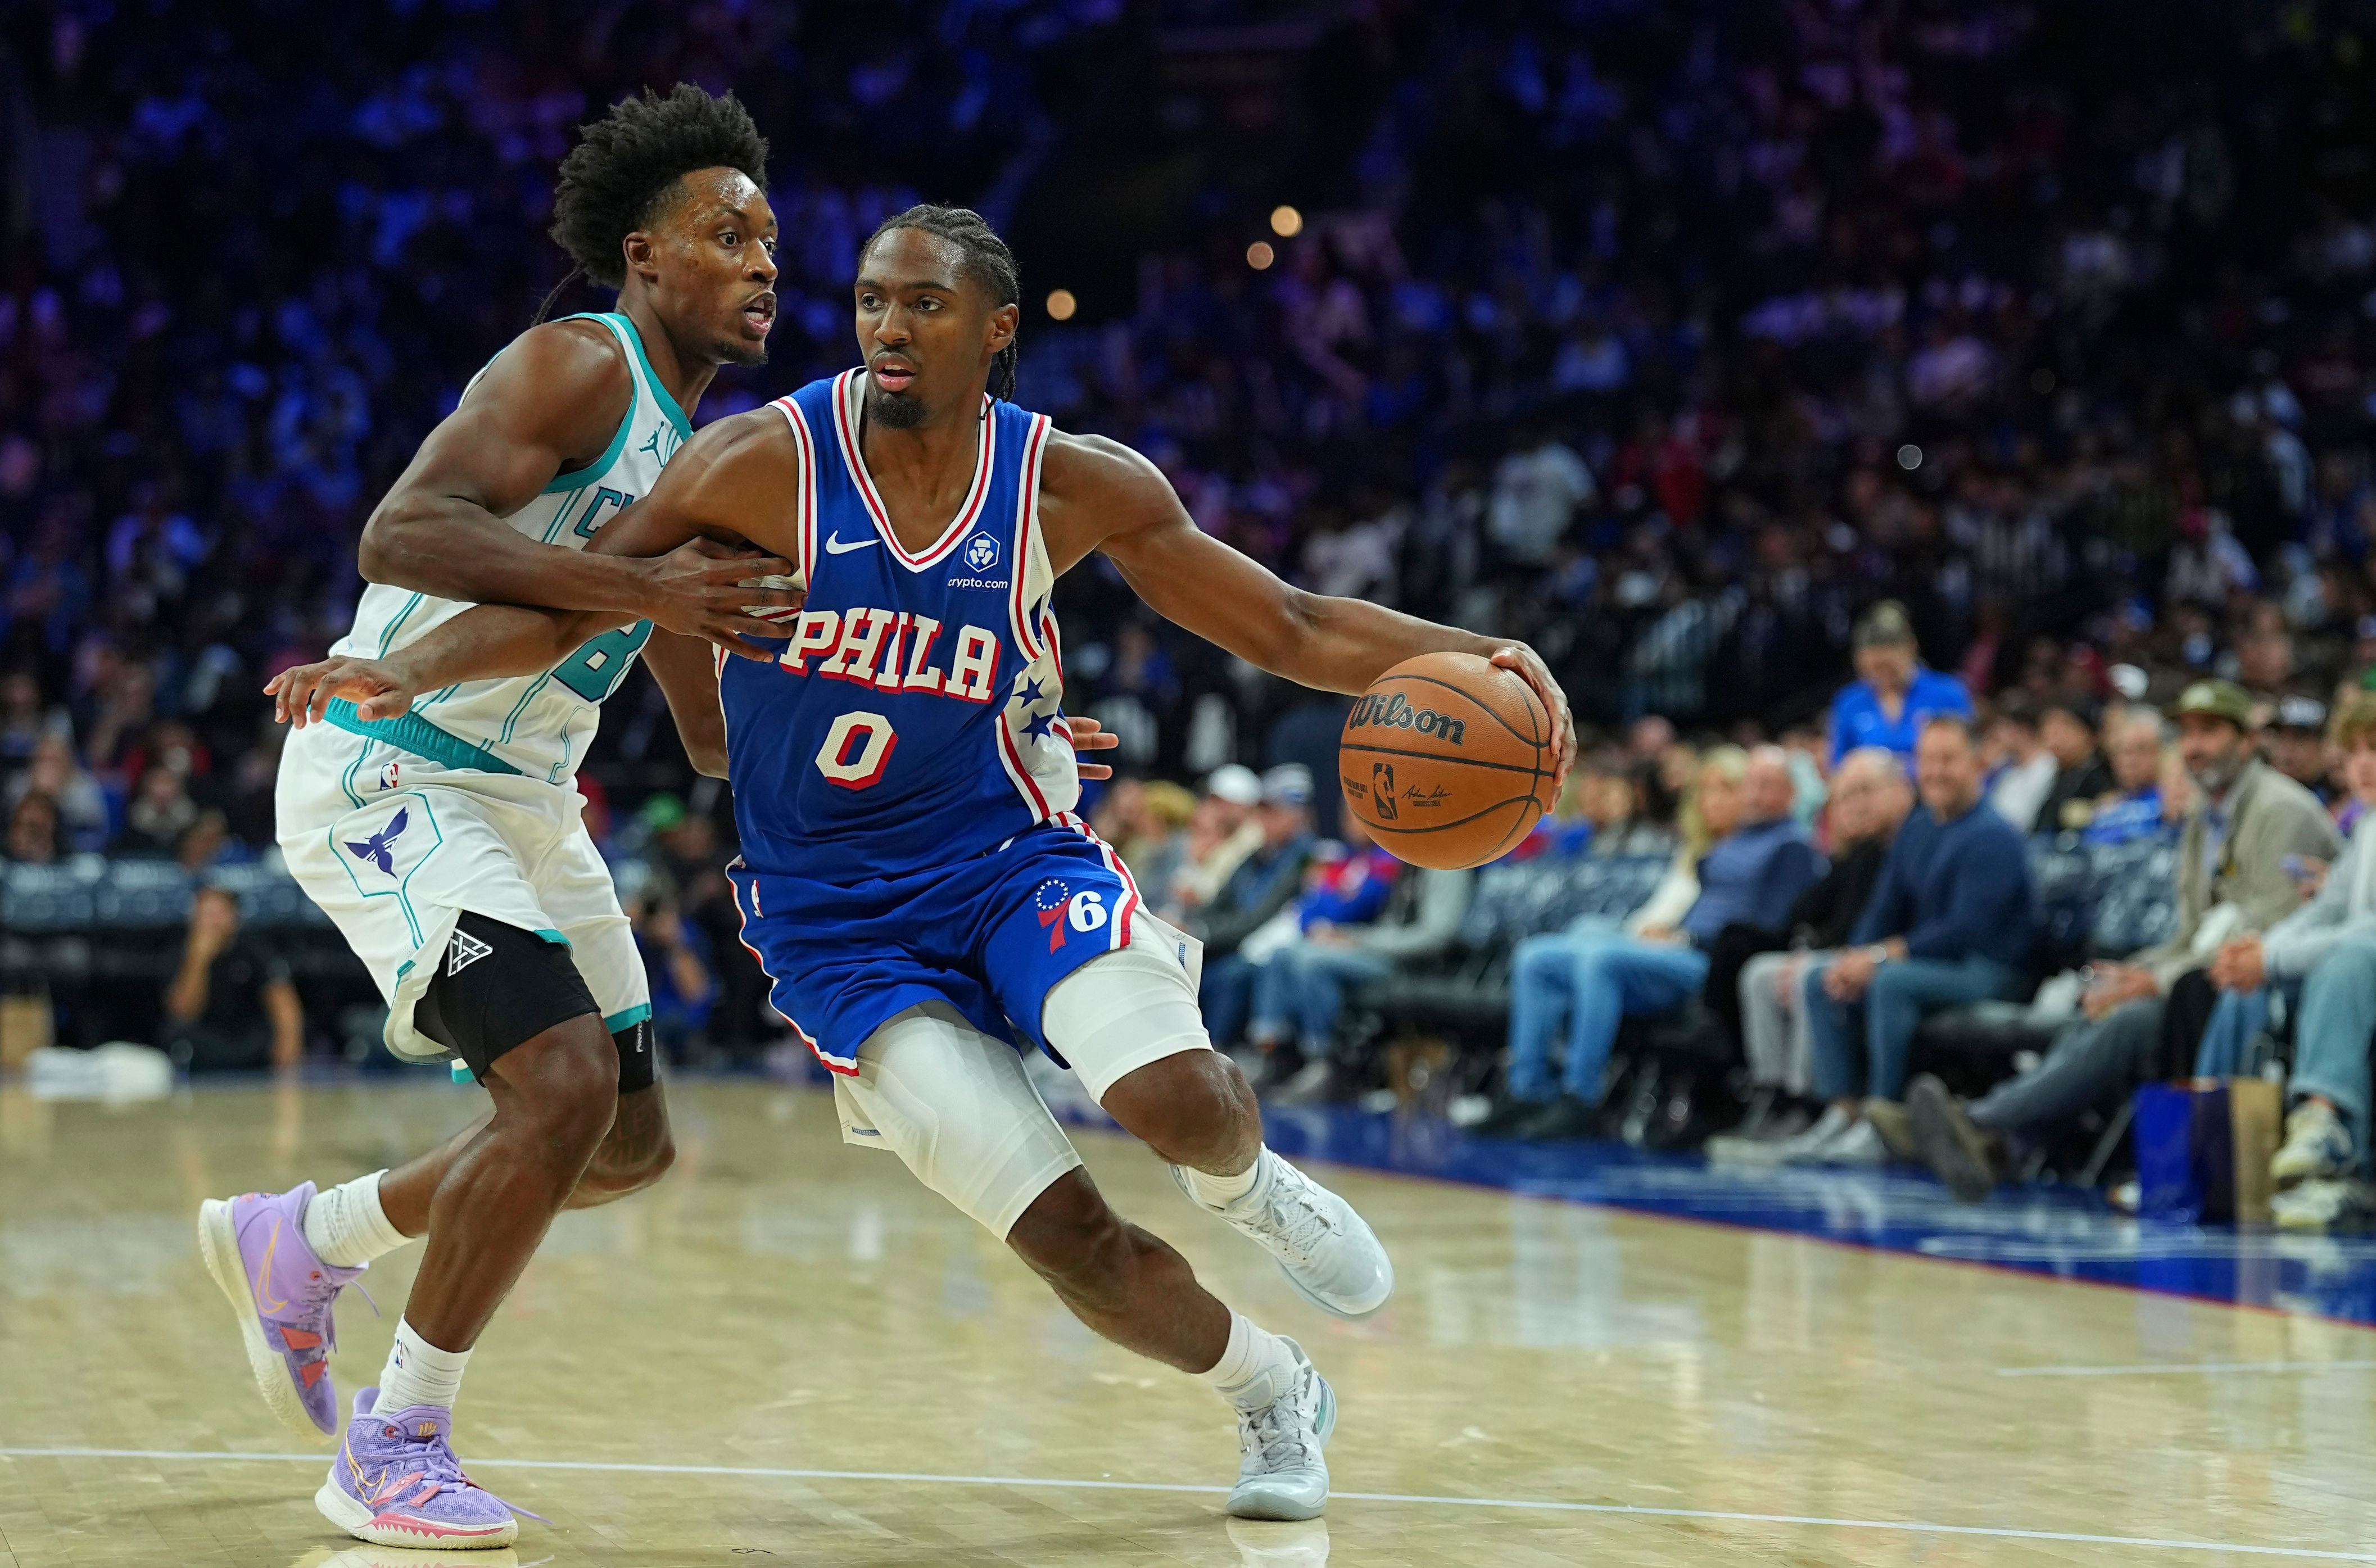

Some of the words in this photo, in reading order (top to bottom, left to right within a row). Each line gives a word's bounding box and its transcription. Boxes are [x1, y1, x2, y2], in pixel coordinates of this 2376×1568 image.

[574, 486, 635, 539] C
[948, 577, 1008, 589] crypto.com
[779, 607, 1002, 704] PHILA
[1350, 692, 1466, 746] Wilson
[815, 710, 899, 791] 0
[1037, 890, 1107, 955] 76
